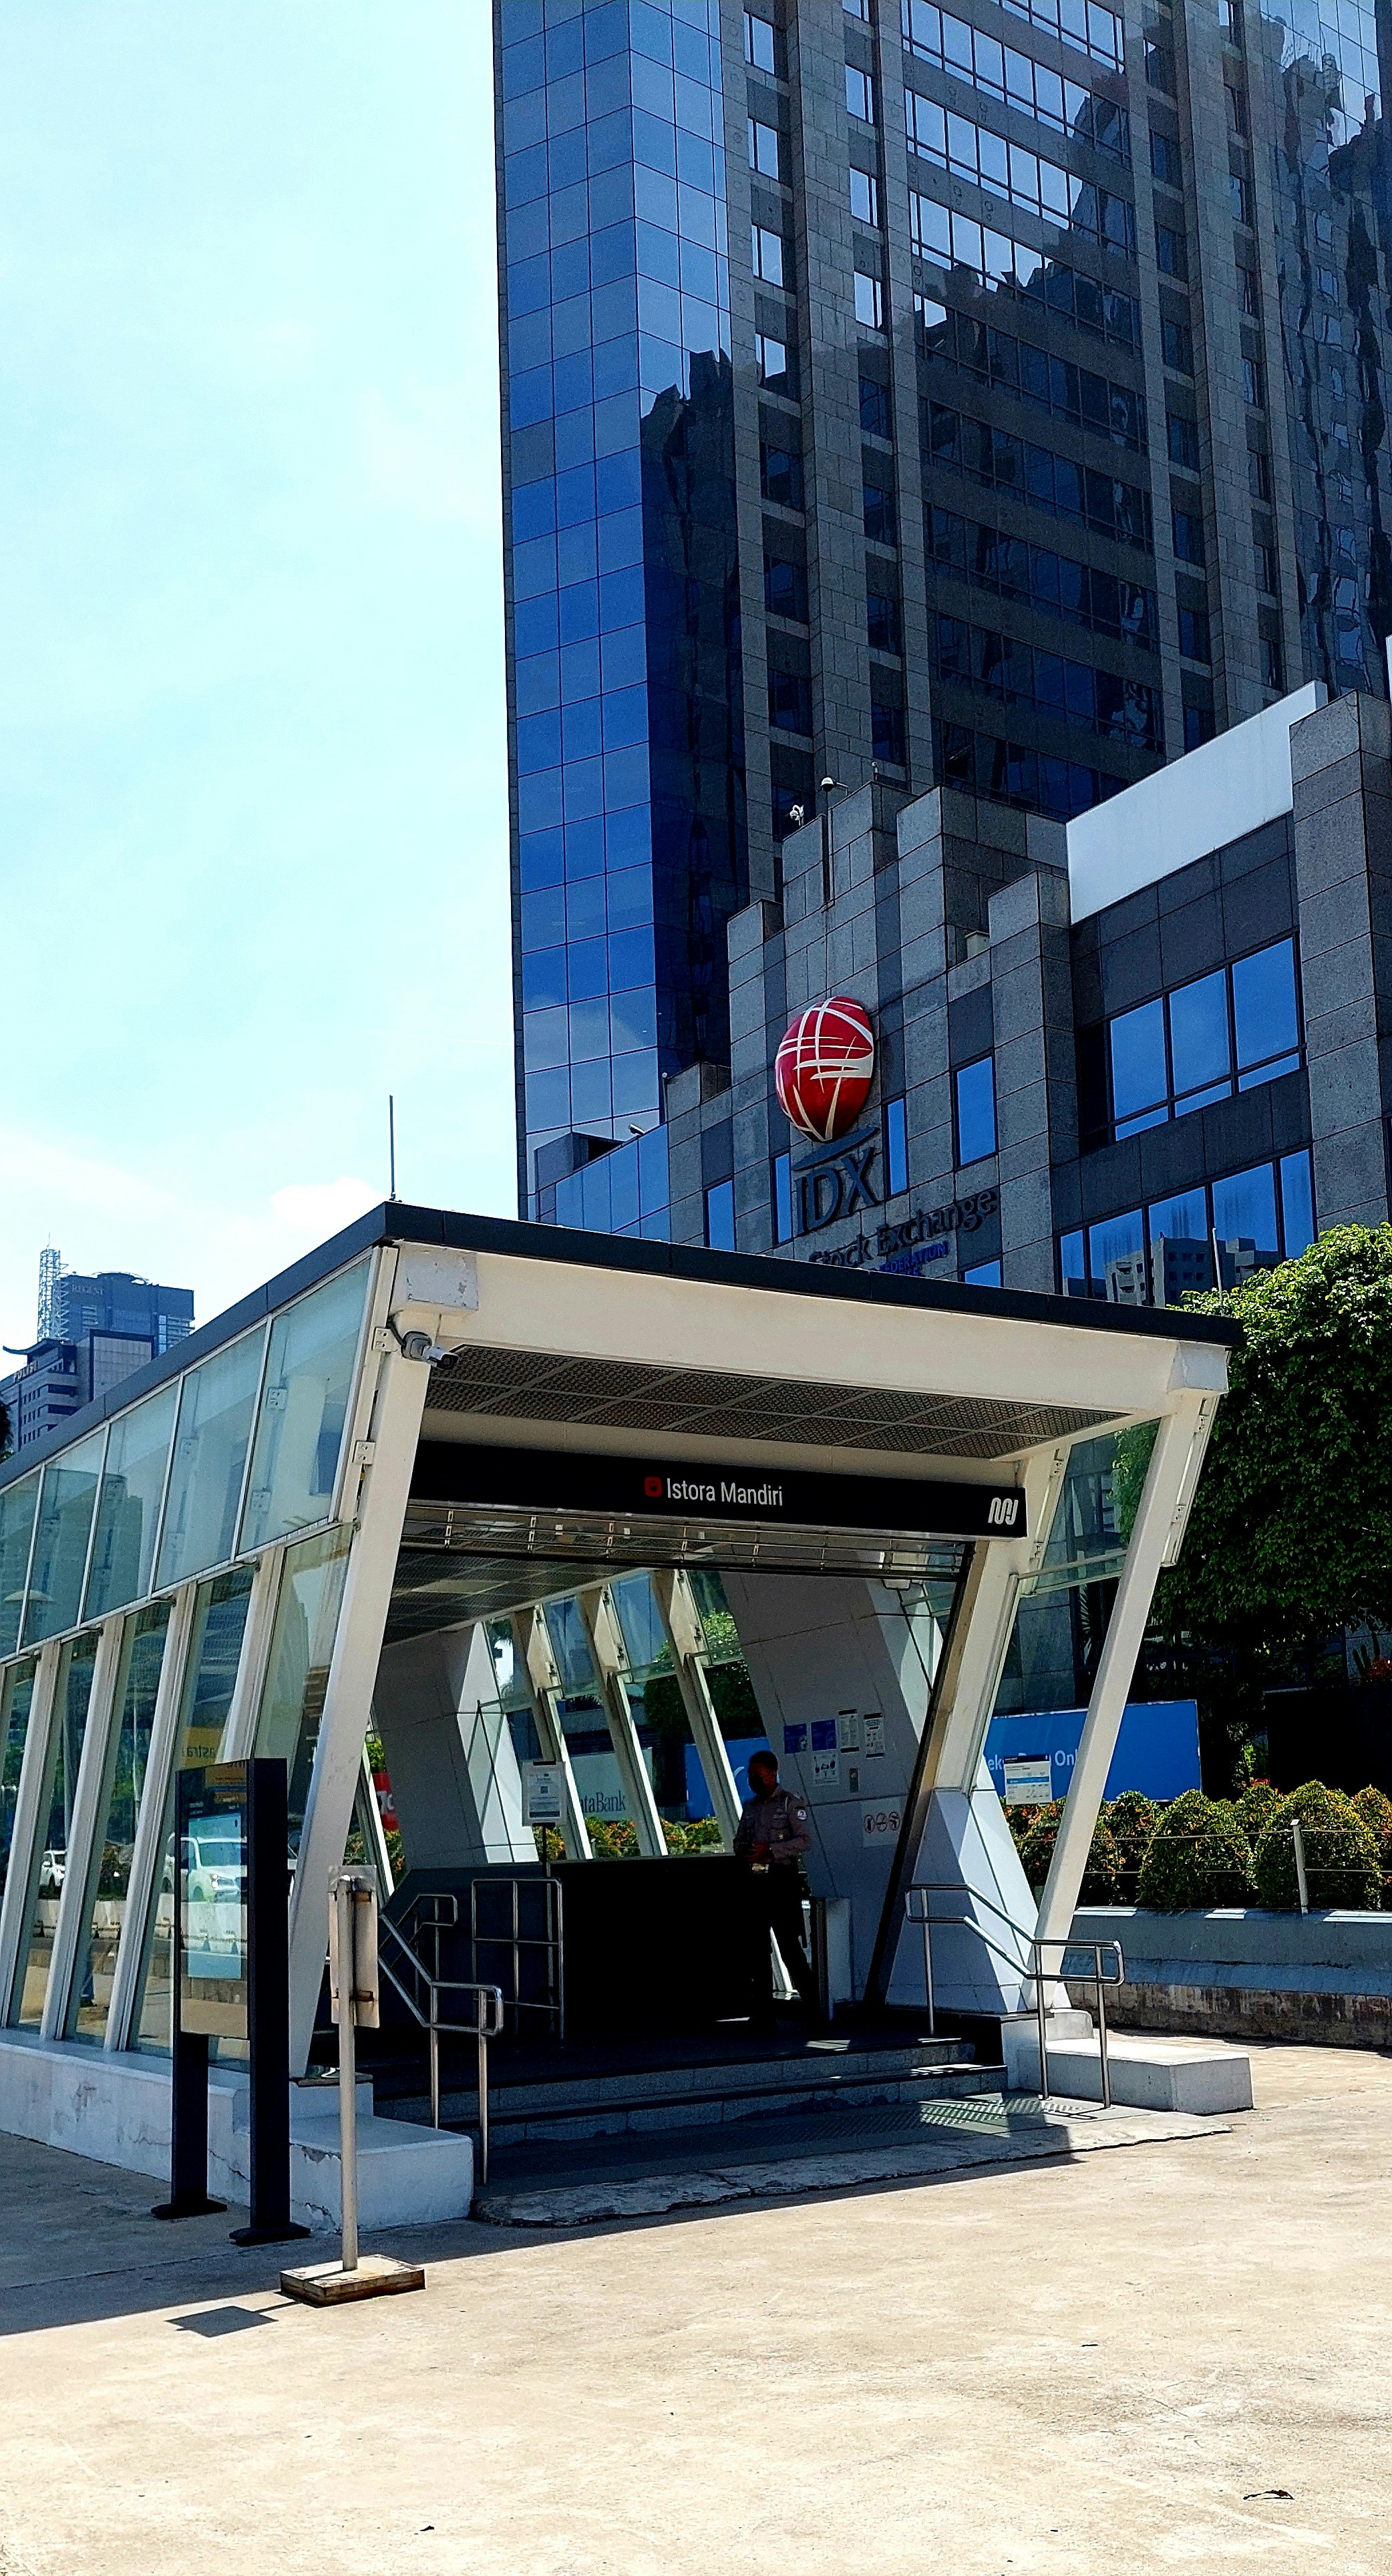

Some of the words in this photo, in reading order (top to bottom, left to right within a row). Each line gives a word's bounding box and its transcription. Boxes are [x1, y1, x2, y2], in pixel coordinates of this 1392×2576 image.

[794, 1146, 882, 1237] IDX
[876, 1189, 999, 1257] Exchange
[667, 1478, 715, 1501] Istora
[721, 1481, 783, 1506] Mandiri
